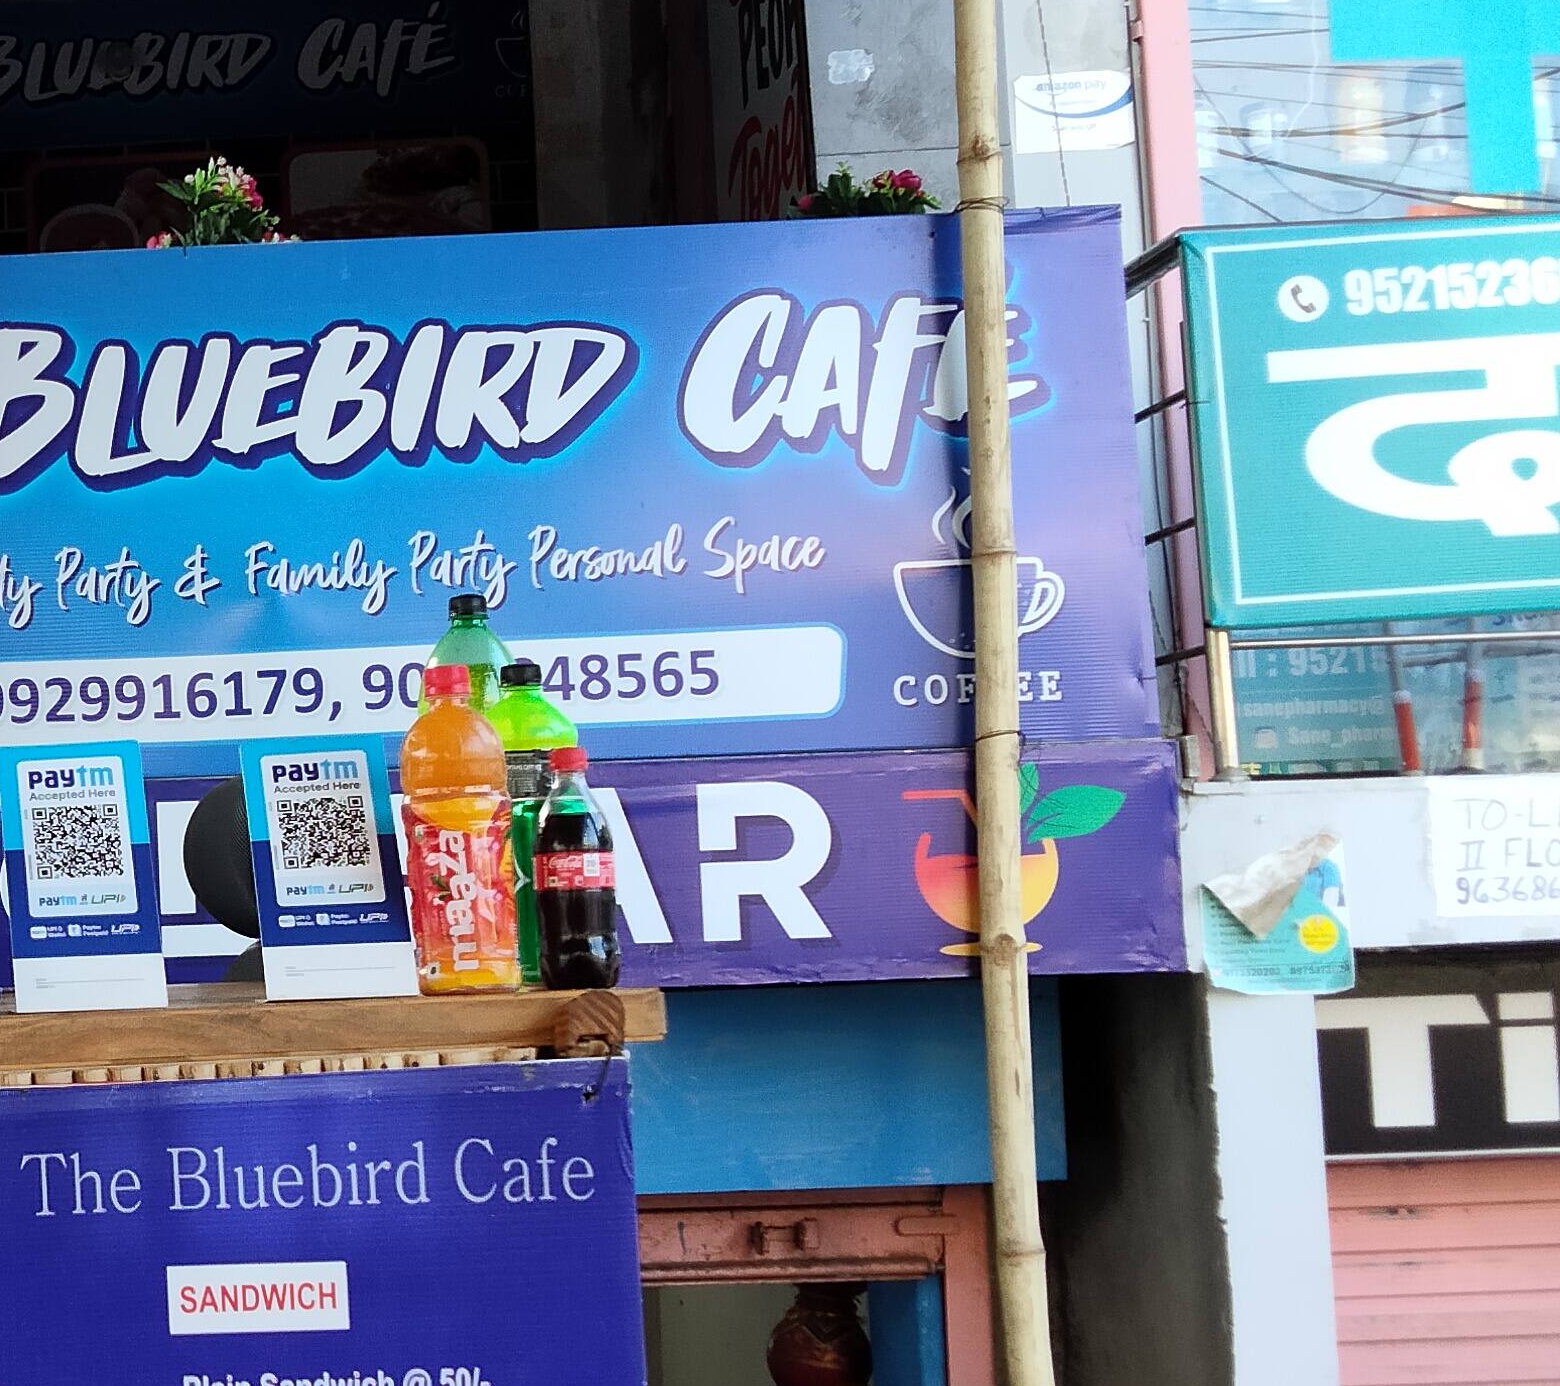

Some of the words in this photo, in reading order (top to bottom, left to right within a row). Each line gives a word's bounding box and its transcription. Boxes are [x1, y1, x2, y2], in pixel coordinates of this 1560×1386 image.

[54, 545, 162, 625] Party
[174, 543, 221, 606] &
[244, 535, 398, 615] Family
[408, 528, 517, 609] Party
[527, 522, 687, 590] Personal
[703, 514, 827, 594] Space
[362, 649, 721, 712] 9048565
[893, 669, 1063, 707] COFEE
[28, 789, 87, 803] Accepted
[88, 787, 117, 800] Here
[273, 783, 331, 796] Accepted
[332, 781, 361, 793] Here
[1452, 797, 1560, 832] TO-L
[19, 1151, 141, 1216] The
[166, 1140, 430, 1210] Bluebird
[453, 1136, 595, 1203] Cafe
[178, 1280, 337, 1315] SANDWICH
